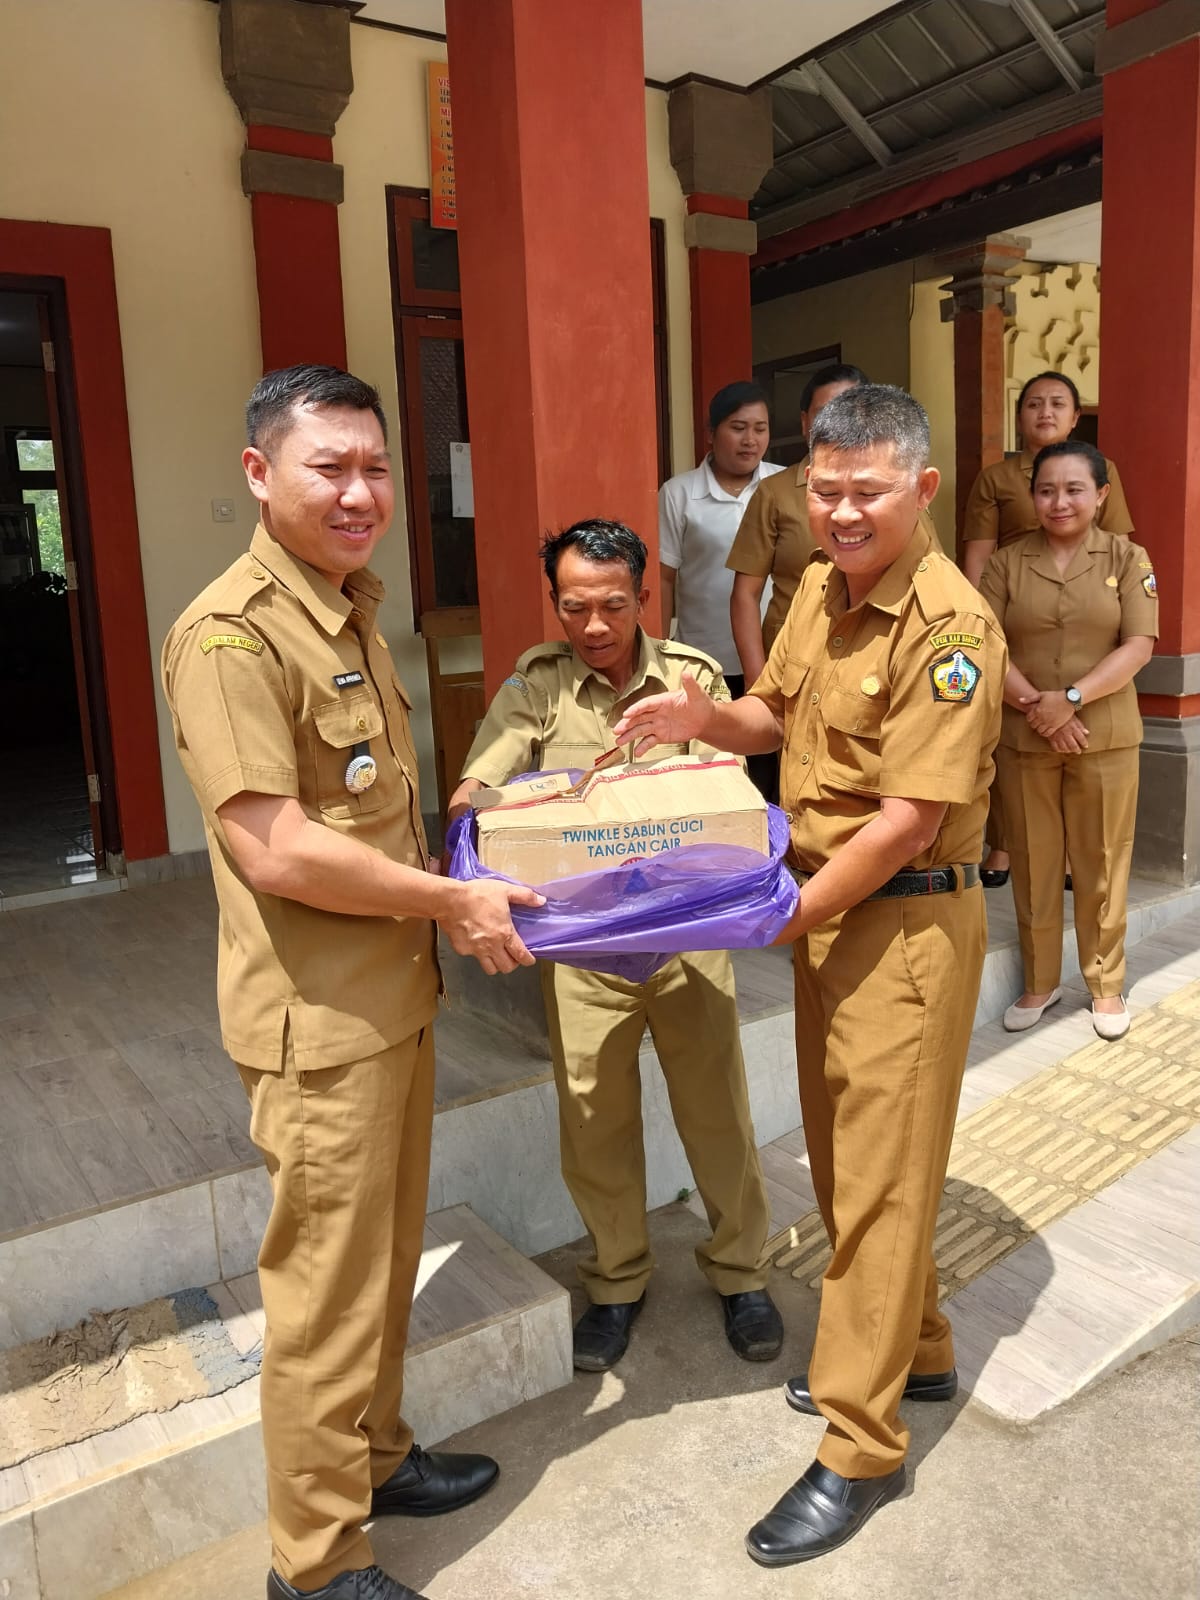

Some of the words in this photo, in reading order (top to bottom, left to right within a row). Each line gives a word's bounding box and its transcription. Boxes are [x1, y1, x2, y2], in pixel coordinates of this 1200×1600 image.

[437, 78, 450, 88] VIS
[562, 827, 620, 843] TWINKLE
[623, 823, 666, 839] SABUN
[669, 819, 703, 835] CUCI
[587, 841, 646, 858] TANGAN
[650, 838, 681, 853] CAIR
